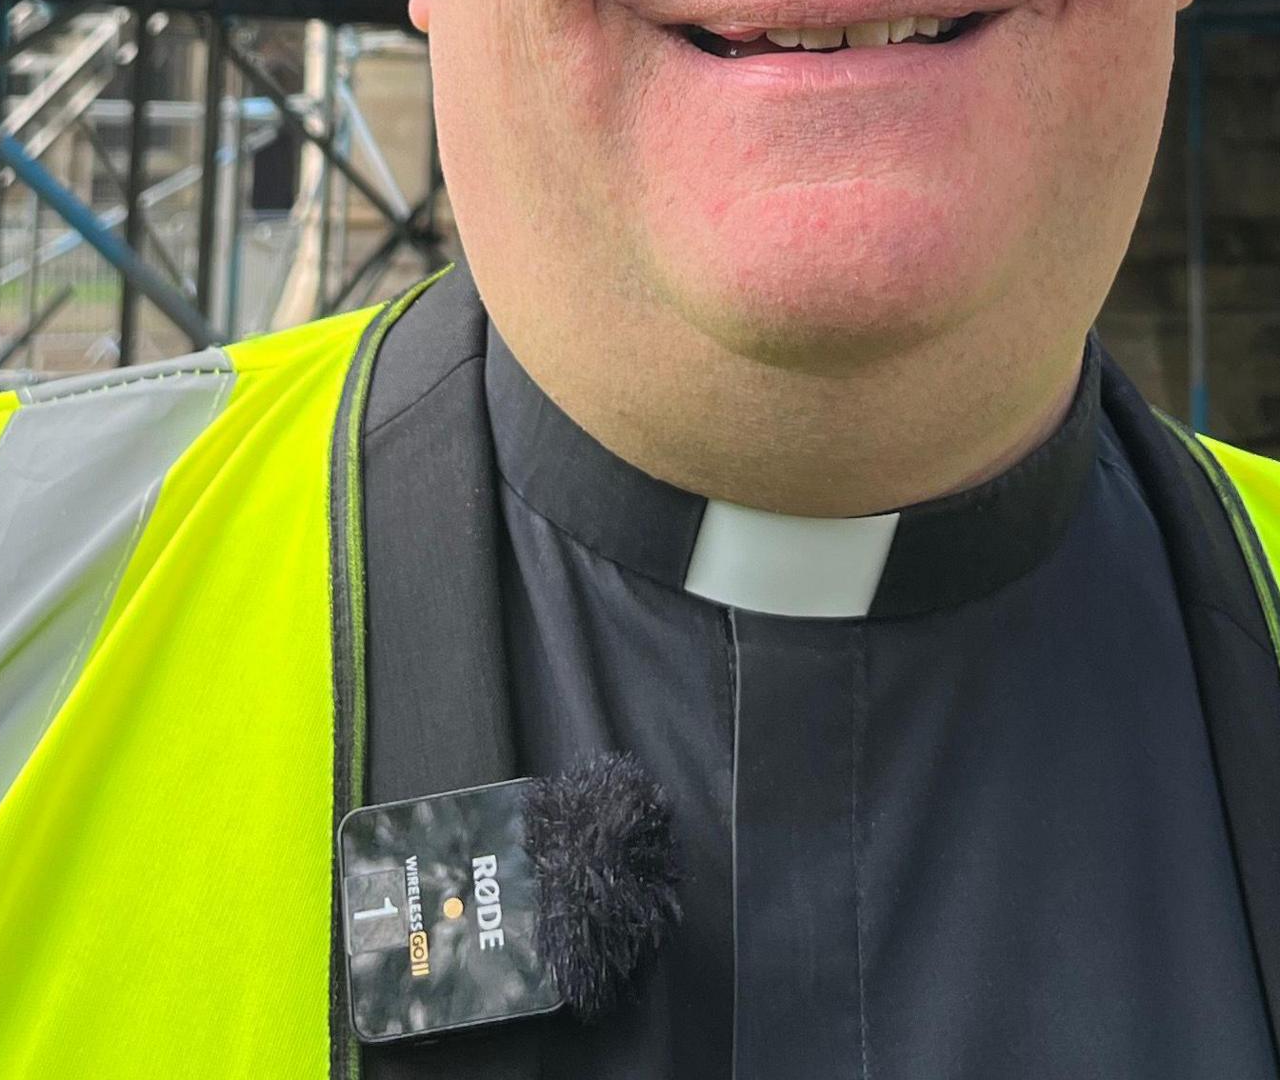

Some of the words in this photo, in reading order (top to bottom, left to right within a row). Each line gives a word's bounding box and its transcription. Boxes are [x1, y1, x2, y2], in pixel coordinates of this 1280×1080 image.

[353, 896, 399, 920] 1
[405, 855, 424, 932] WIRELESS
[471, 854, 505, 951] RØDE
